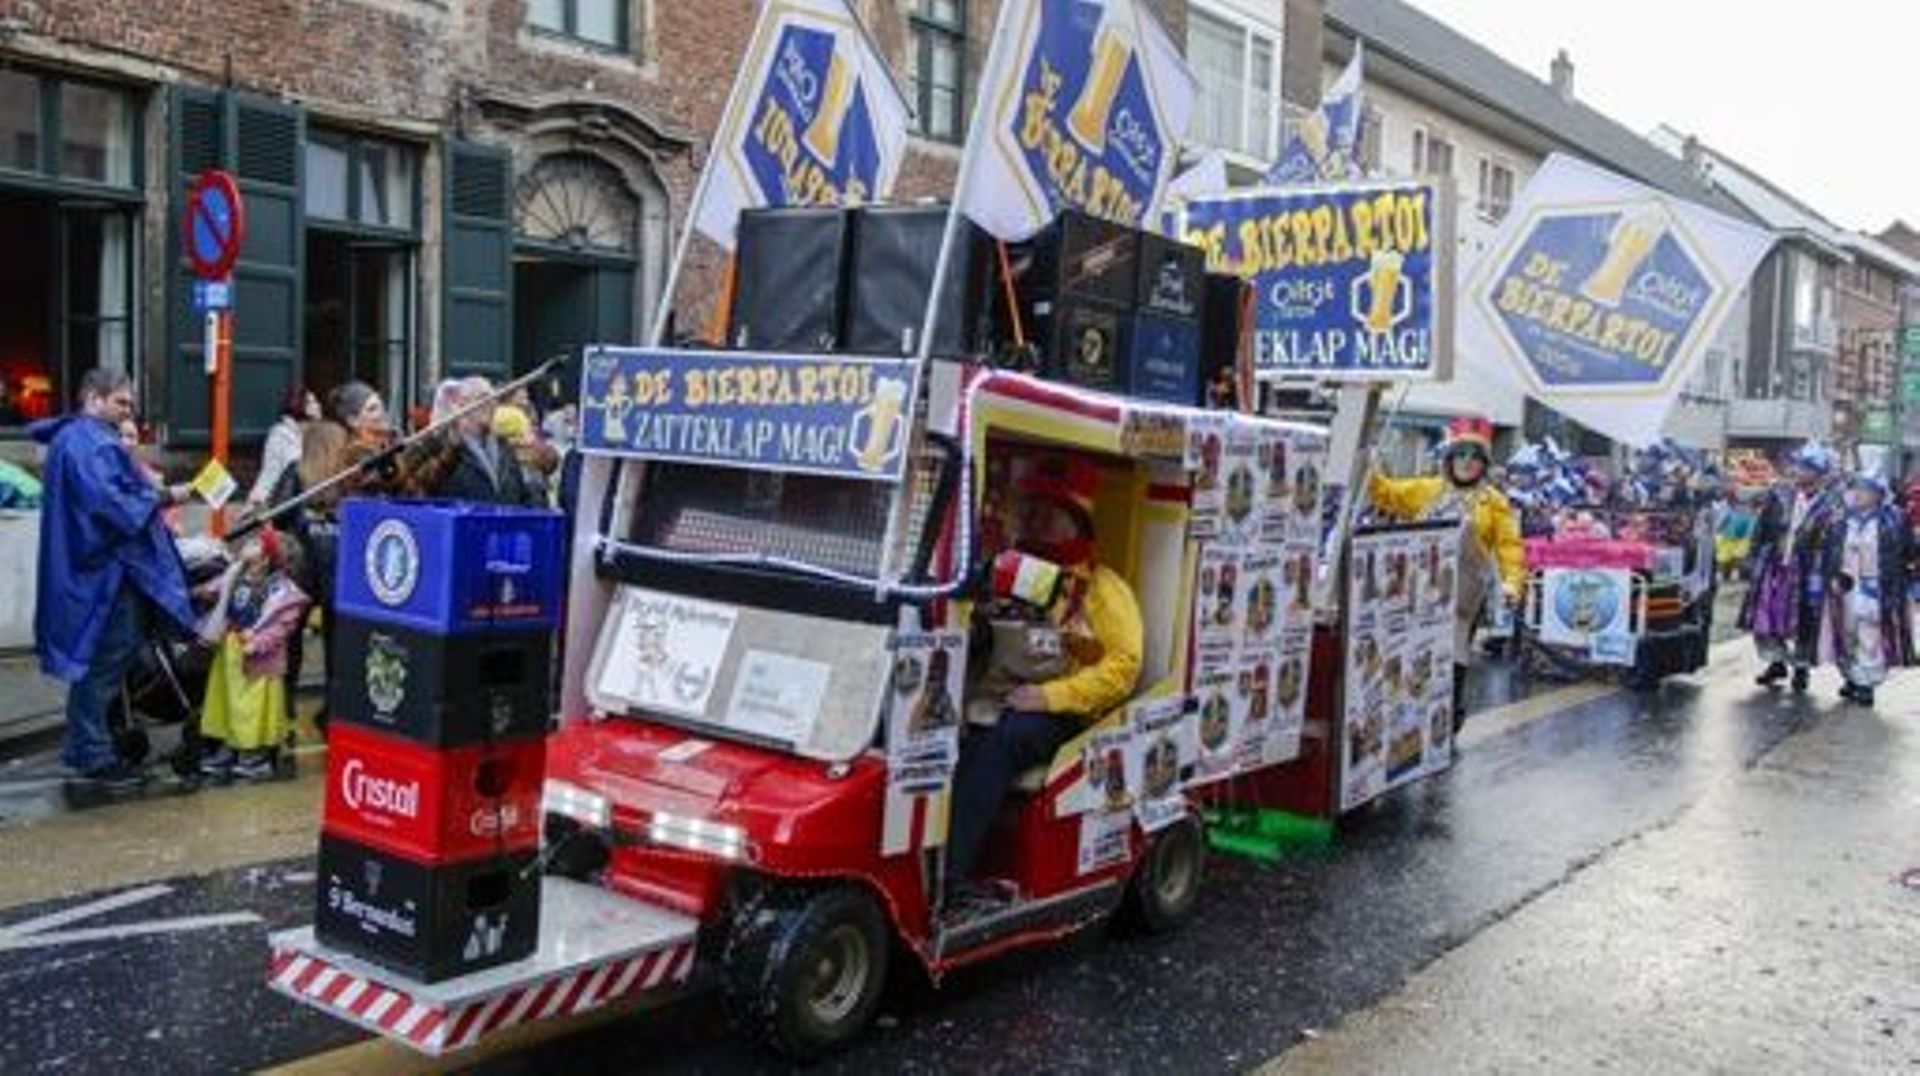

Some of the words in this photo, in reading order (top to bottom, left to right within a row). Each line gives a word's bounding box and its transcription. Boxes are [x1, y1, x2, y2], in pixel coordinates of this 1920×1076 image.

[1239, 193, 1429, 281] BIERPARTOI
[1524, 253, 1569, 288] DE
[1354, 327, 1428, 364] MAG!
[1498, 275, 1677, 367] BIERPARTOI
[635, 369, 672, 405] DE
[684, 365, 874, 406] BIERPARTOI
[635, 414, 773, 459] ZATTEKLAP
[781, 422, 847, 464] MAG!
[342, 758, 420, 819] Cristal
